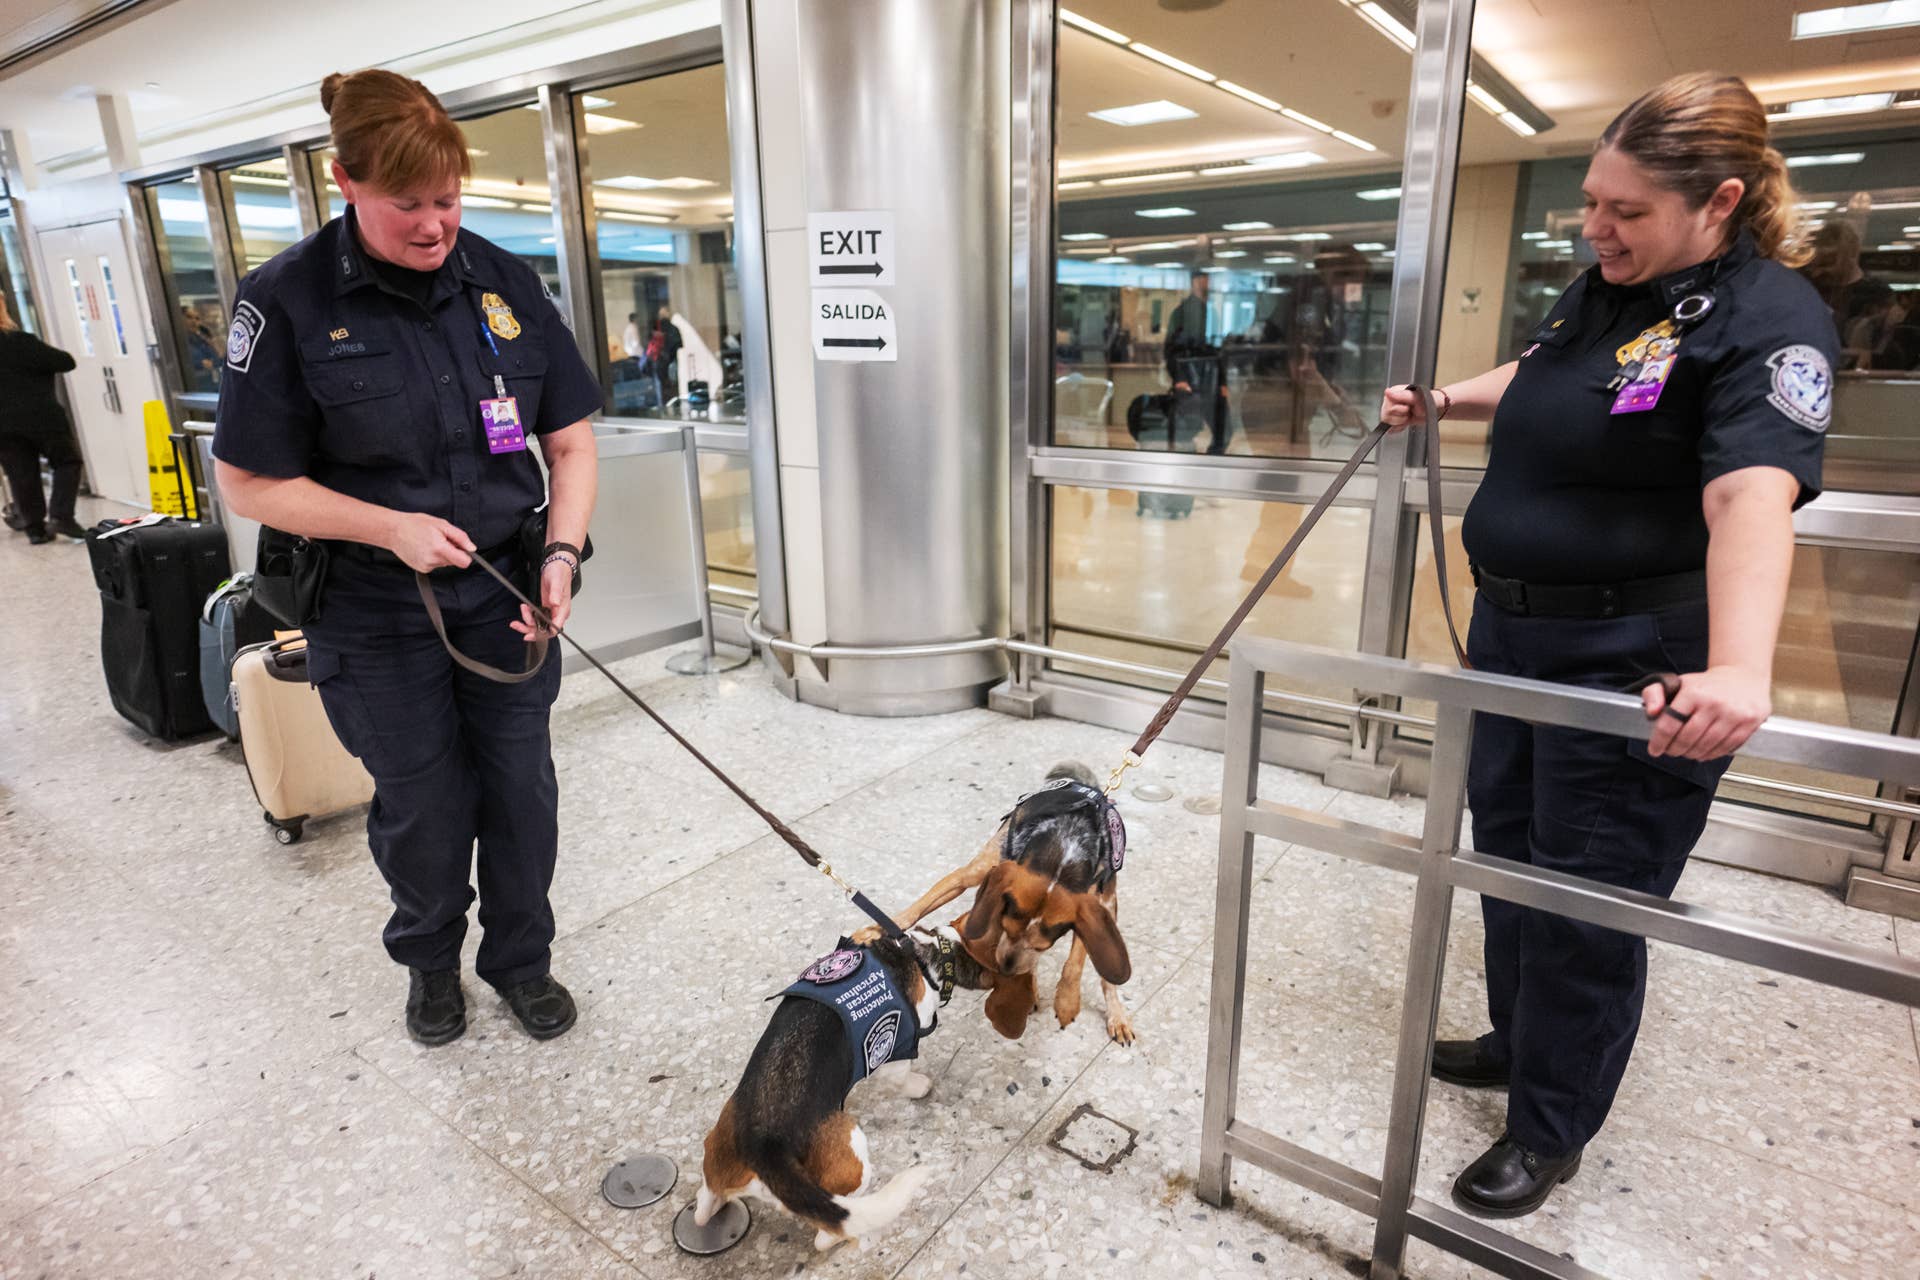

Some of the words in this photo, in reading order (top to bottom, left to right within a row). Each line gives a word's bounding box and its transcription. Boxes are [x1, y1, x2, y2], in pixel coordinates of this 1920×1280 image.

[820, 230, 882, 255] EXIT
[821, 304, 887, 320] SALIDA
[329, 327, 350, 341] K9
[328, 342, 366, 356] JONES
[835, 969, 886, 1005] Agriculture
[846, 980, 887, 1010] American
[850, 990, 894, 1021] Protecting
